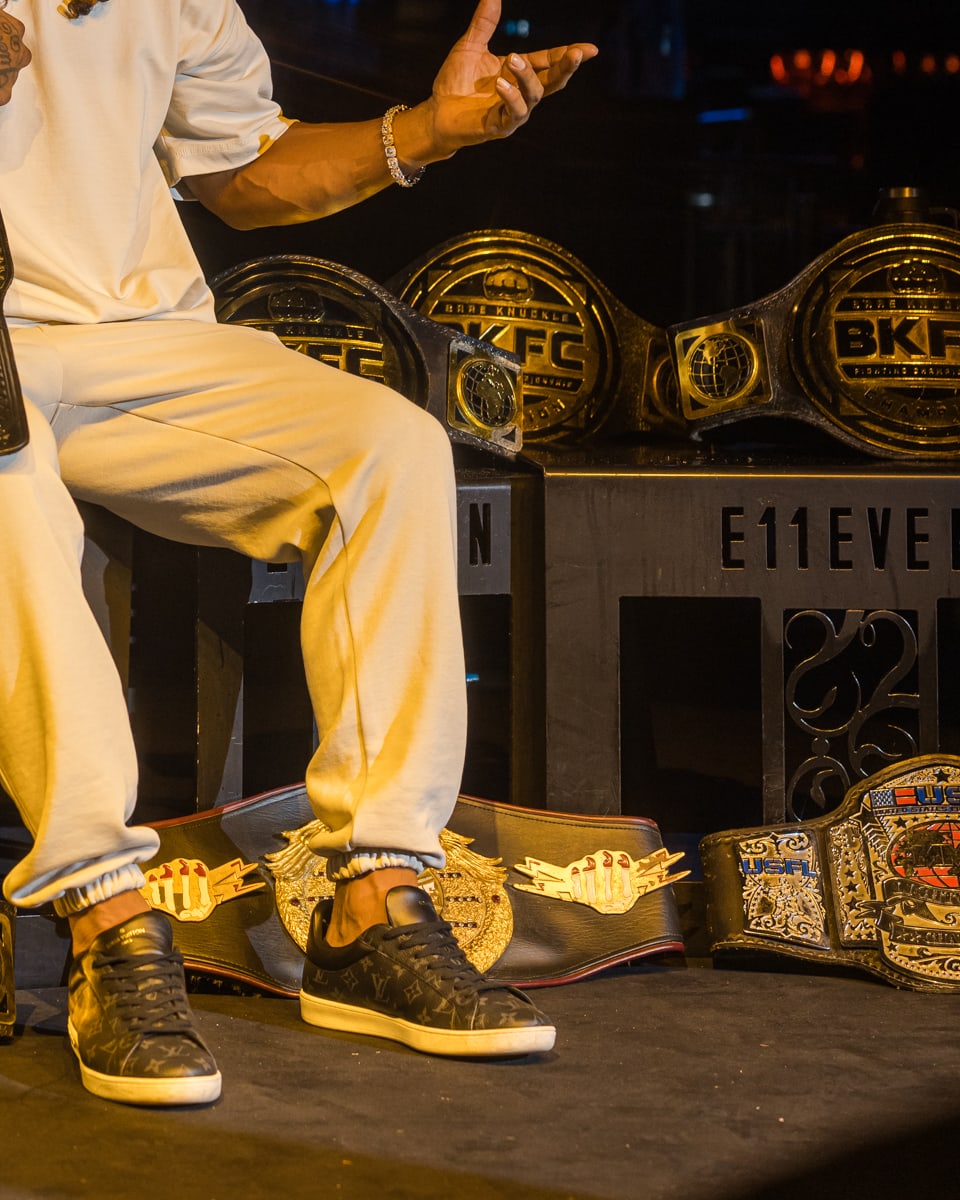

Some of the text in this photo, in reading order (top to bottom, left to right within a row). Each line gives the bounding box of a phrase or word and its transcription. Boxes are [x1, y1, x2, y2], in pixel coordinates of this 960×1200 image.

[445, 304, 569, 322] BARE KNUCKLE
[741, 857, 816, 876] USFL
